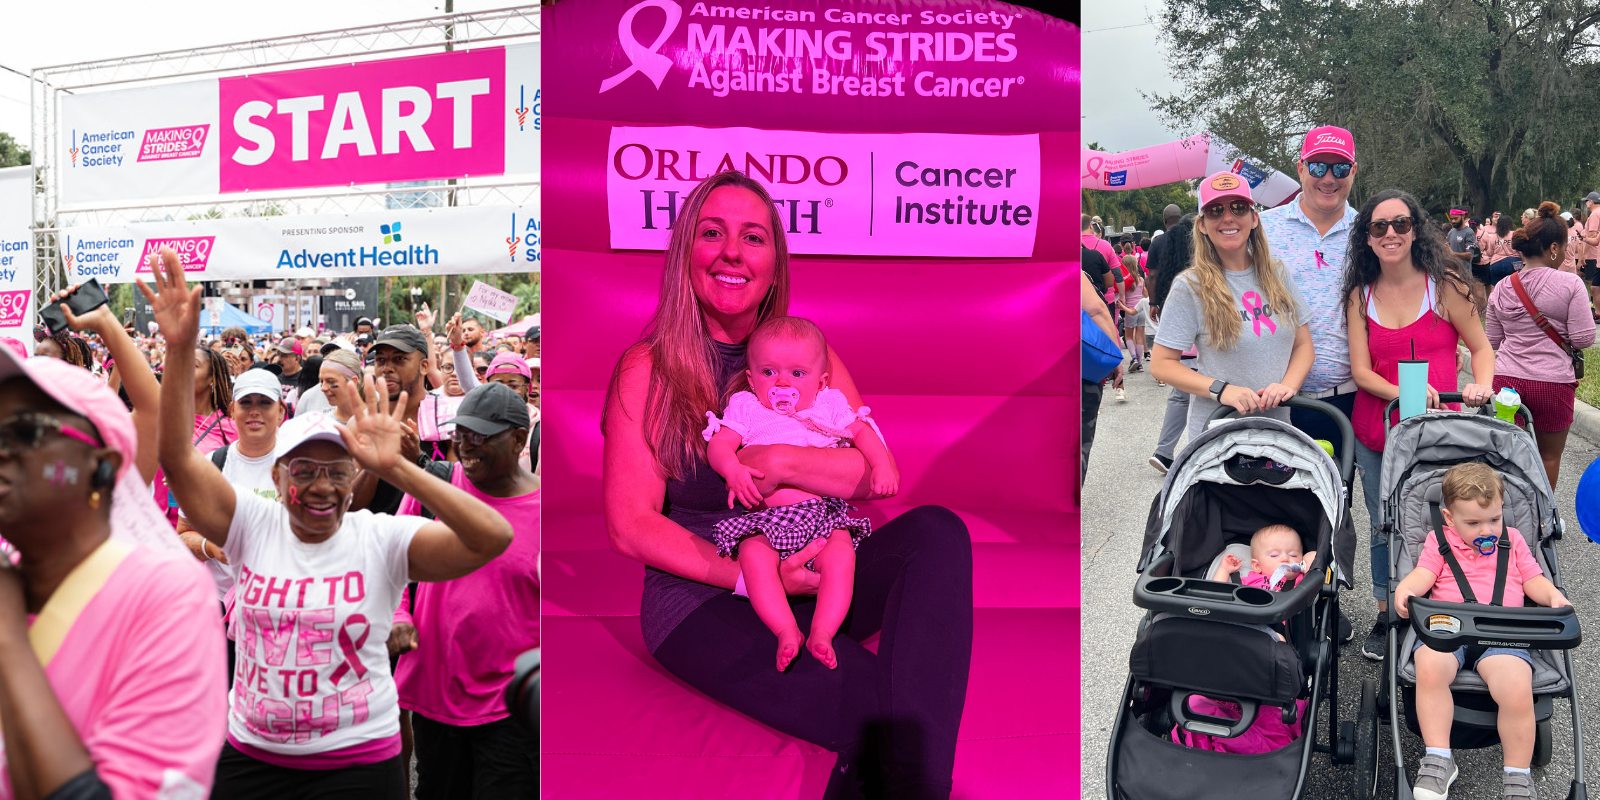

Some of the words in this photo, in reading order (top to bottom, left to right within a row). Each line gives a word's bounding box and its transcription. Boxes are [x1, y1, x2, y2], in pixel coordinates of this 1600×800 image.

[690, 2, 815, 22] American
[824, 8, 912, 26] Cancer
[687, 23, 852, 60] MAKING
[865, 31, 1018, 62] STRIDES
[688, 62, 803, 97] Against
[812, 68, 905, 96] Breast
[231, 78, 490, 166] START
[82, 130, 135, 143] American
[146, 129, 193, 143] MAKING
[82, 144, 122, 155] Cancer
[143, 141, 188, 154] STRIDES
[82, 154, 123, 167] Society
[613, 143, 848, 186] ORLANDO
[895, 161, 1017, 188] Cancer
[895, 195, 1033, 226] Institute
[282, 228, 327, 236] PRESENTING
[328, 226, 364, 235] SPONSOR
[0, 240, 29, 252] ican
[77, 237, 135, 250] American
[76, 251, 119, 263] Cancer
[276, 244, 439, 269] AdventHealth
[77, 264, 121, 277] Society
[323, 571, 366, 604] TO
[278, 669, 318, 697] TO
